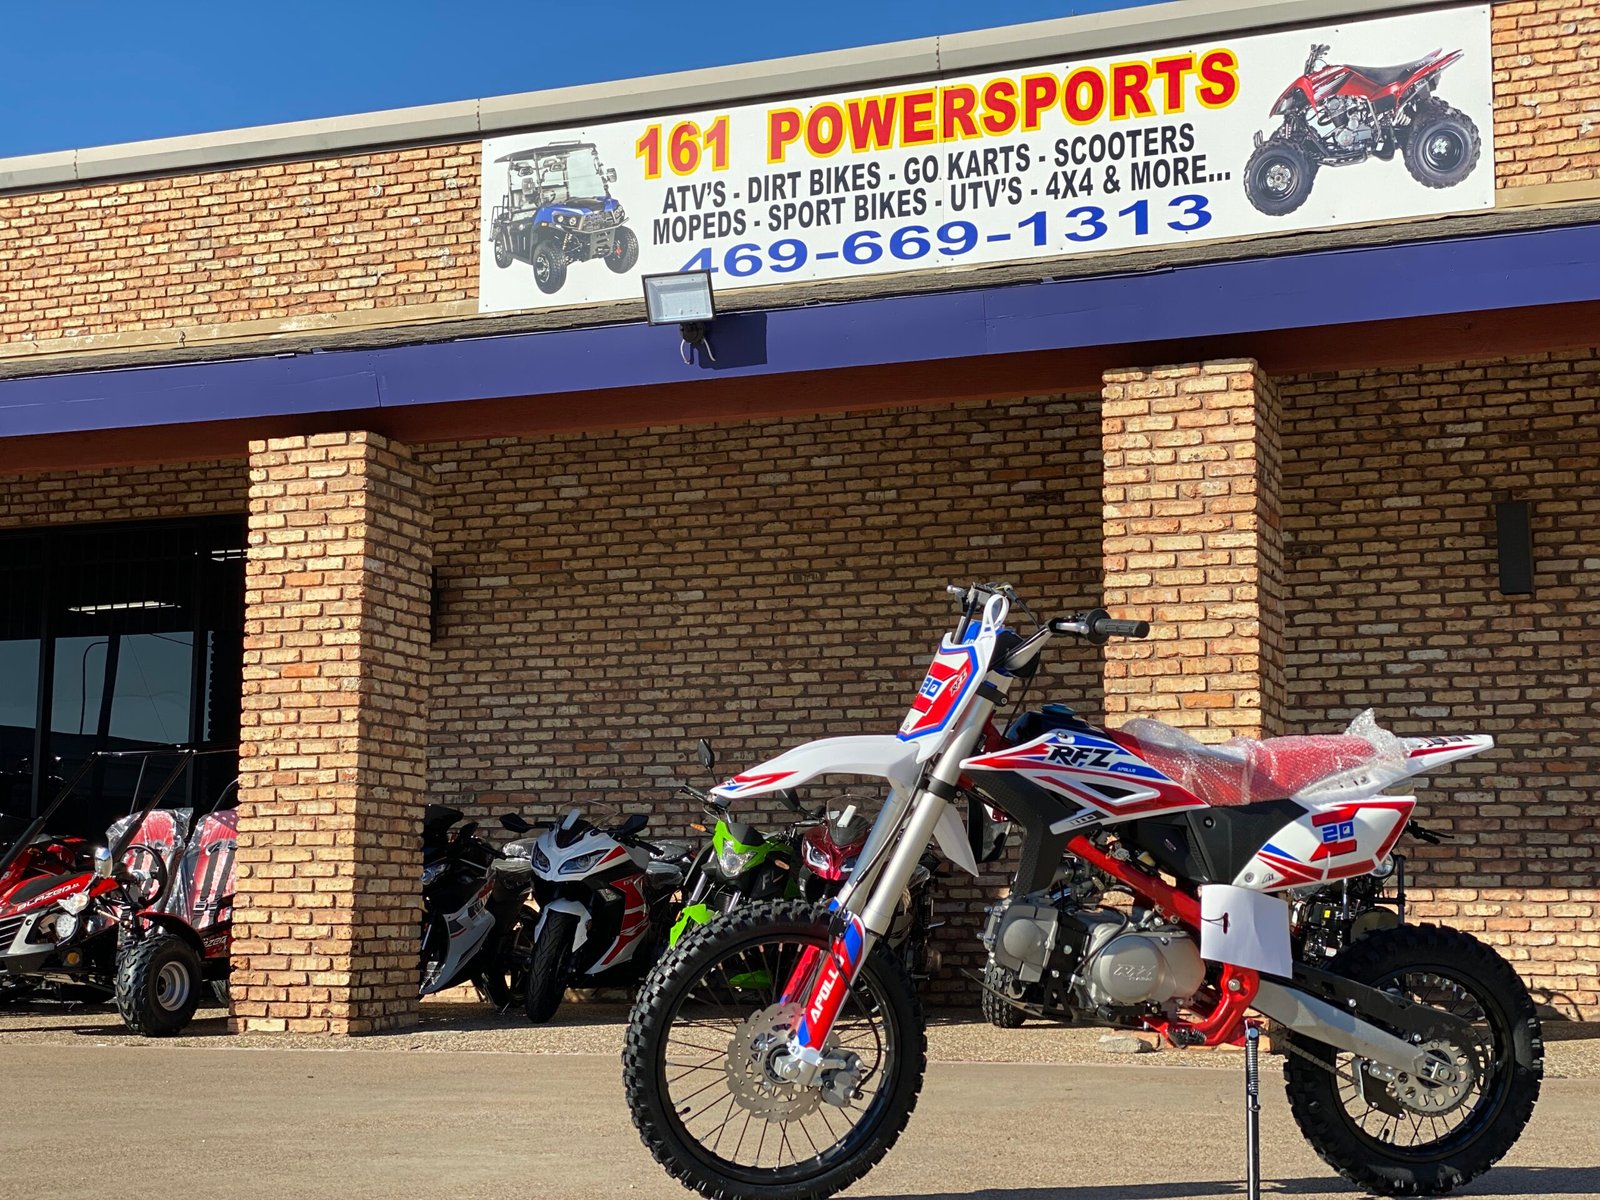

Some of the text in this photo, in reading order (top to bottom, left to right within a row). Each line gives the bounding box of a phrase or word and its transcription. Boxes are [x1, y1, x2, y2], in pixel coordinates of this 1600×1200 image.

[635, 48, 1239, 180] 161 POWERSPORTS
[652, 208, 747, 245] MOPEDS
[767, 197, 846, 232] SPORT
[854, 187, 927, 222] BIKES
[951, 176, 1022, 212] UTV'S
[1046, 167, 1093, 200] 4X4
[1103, 164, 1121, 193] &
[1131, 154, 1231, 191] MORE...
[662, 180, 726, 214] ATV'S
[748, 171, 801, 203] DIRT
[809, 161, 881, 196] BIKES
[904, 155, 939, 185] GO
[948, 143, 1031, 180] KARTS
[1054, 123, 1195, 167] SCOOTERS
[679, 194, 1212, 277] 469-669-1313
[1047, 744, 1115, 768] RFZ
[1322, 821, 1355, 843] 20
